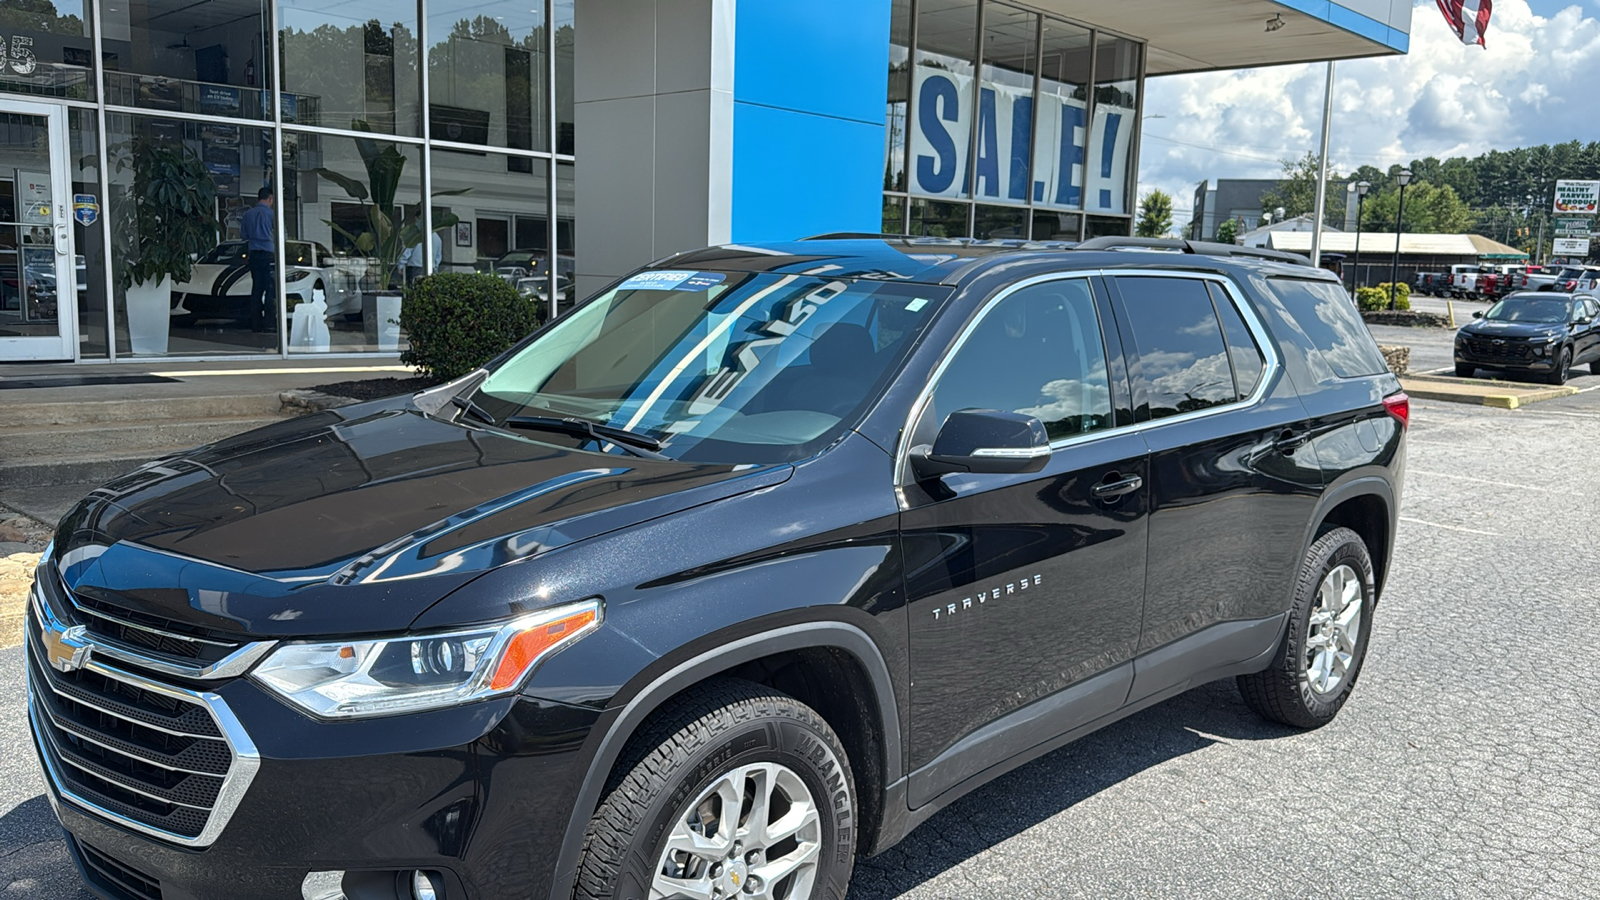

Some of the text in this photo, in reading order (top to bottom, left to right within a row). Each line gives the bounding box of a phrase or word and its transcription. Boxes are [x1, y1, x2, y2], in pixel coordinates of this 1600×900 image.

[916, 74, 1122, 209] SALE!
[630, 273, 689, 282] CERTIFIED
[932, 574, 1042, 620] TRAVERSE
[794, 732, 850, 864] WRANGLER
